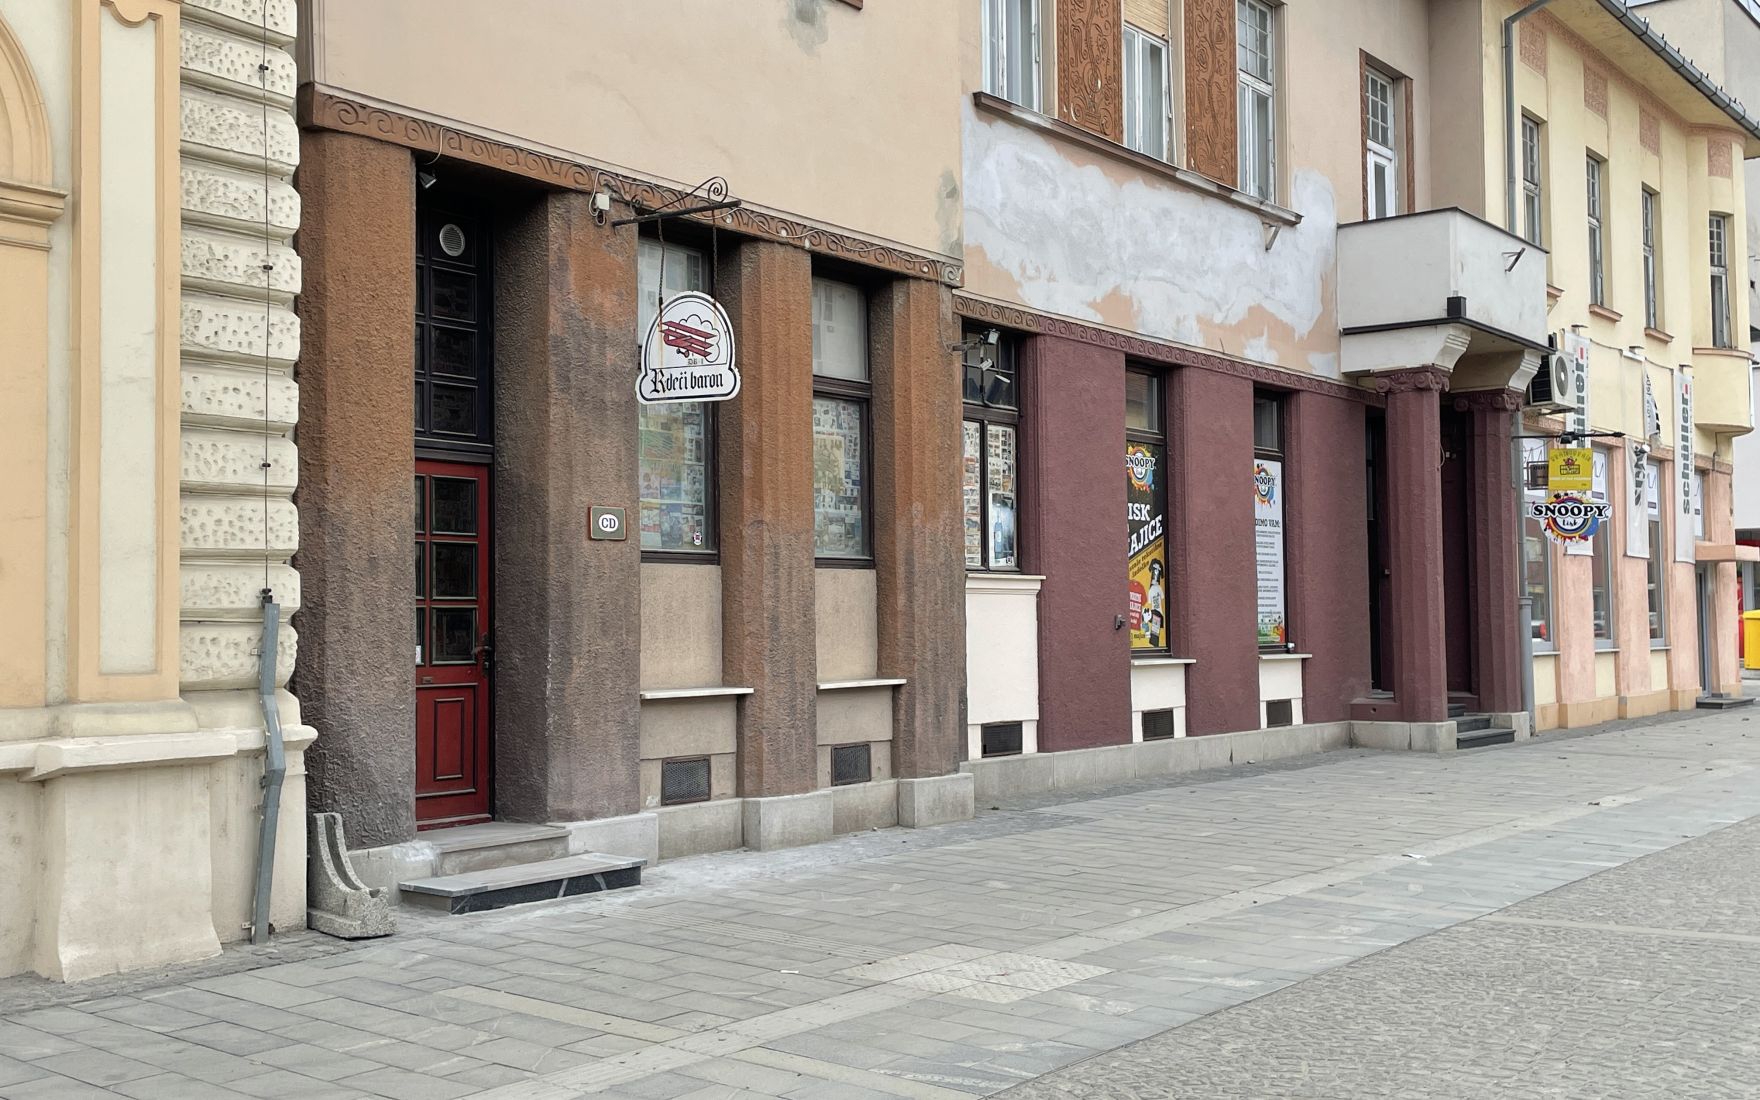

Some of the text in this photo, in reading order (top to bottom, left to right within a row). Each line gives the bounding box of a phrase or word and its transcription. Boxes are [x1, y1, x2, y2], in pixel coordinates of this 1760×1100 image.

[650, 368, 724, 394] Rdeči baron
[1254, 475, 1276, 486] NOOPY
[1127, 502, 1151, 521] ISK
[1533, 504, 1608, 517] SNOOPY
[601, 517, 616, 529] CD
[1127, 513, 1163, 557] AJICE
